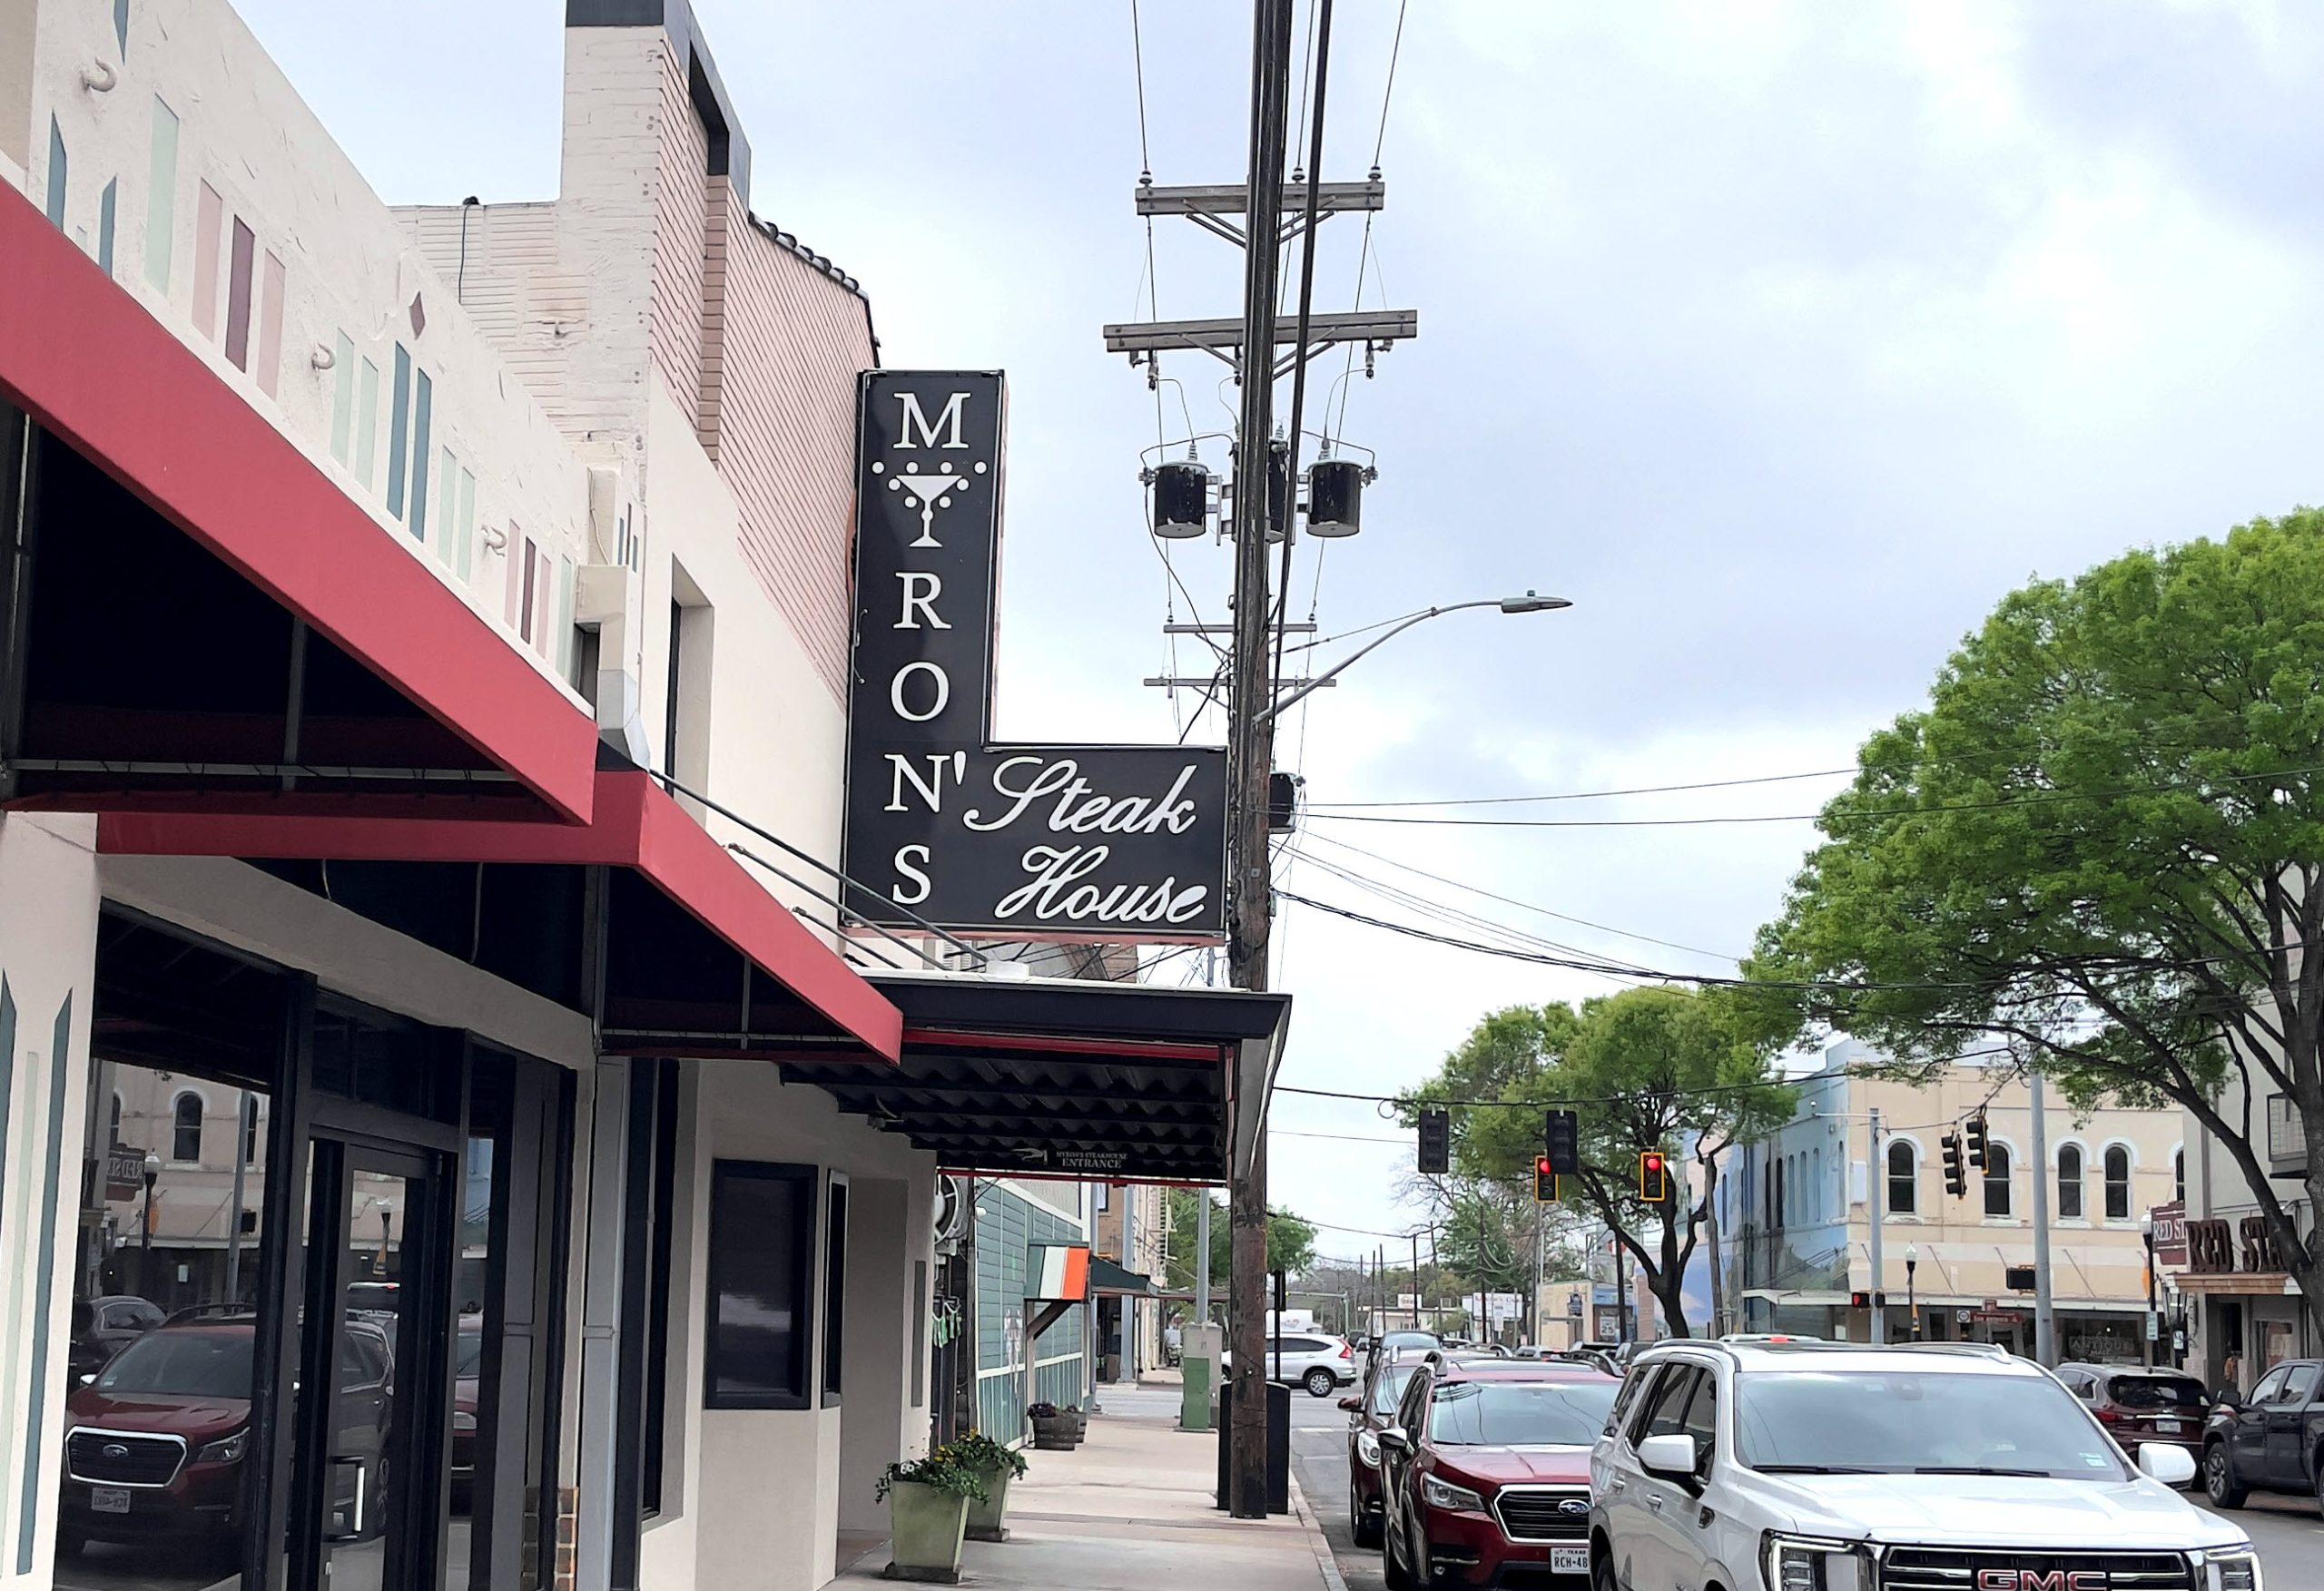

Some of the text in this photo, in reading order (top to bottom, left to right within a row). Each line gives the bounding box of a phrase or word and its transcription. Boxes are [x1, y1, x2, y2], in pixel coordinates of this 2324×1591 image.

[962, 756, 1197, 834] Steak
[994, 844, 1205, 923] House
[1062, 1158, 1122, 1169] ENTRANCE
[2152, 1220, 2173, 1242] RED
[2185, 1219, 2233, 1272] RED
[1977, 1569, 2107, 1591] GMC
